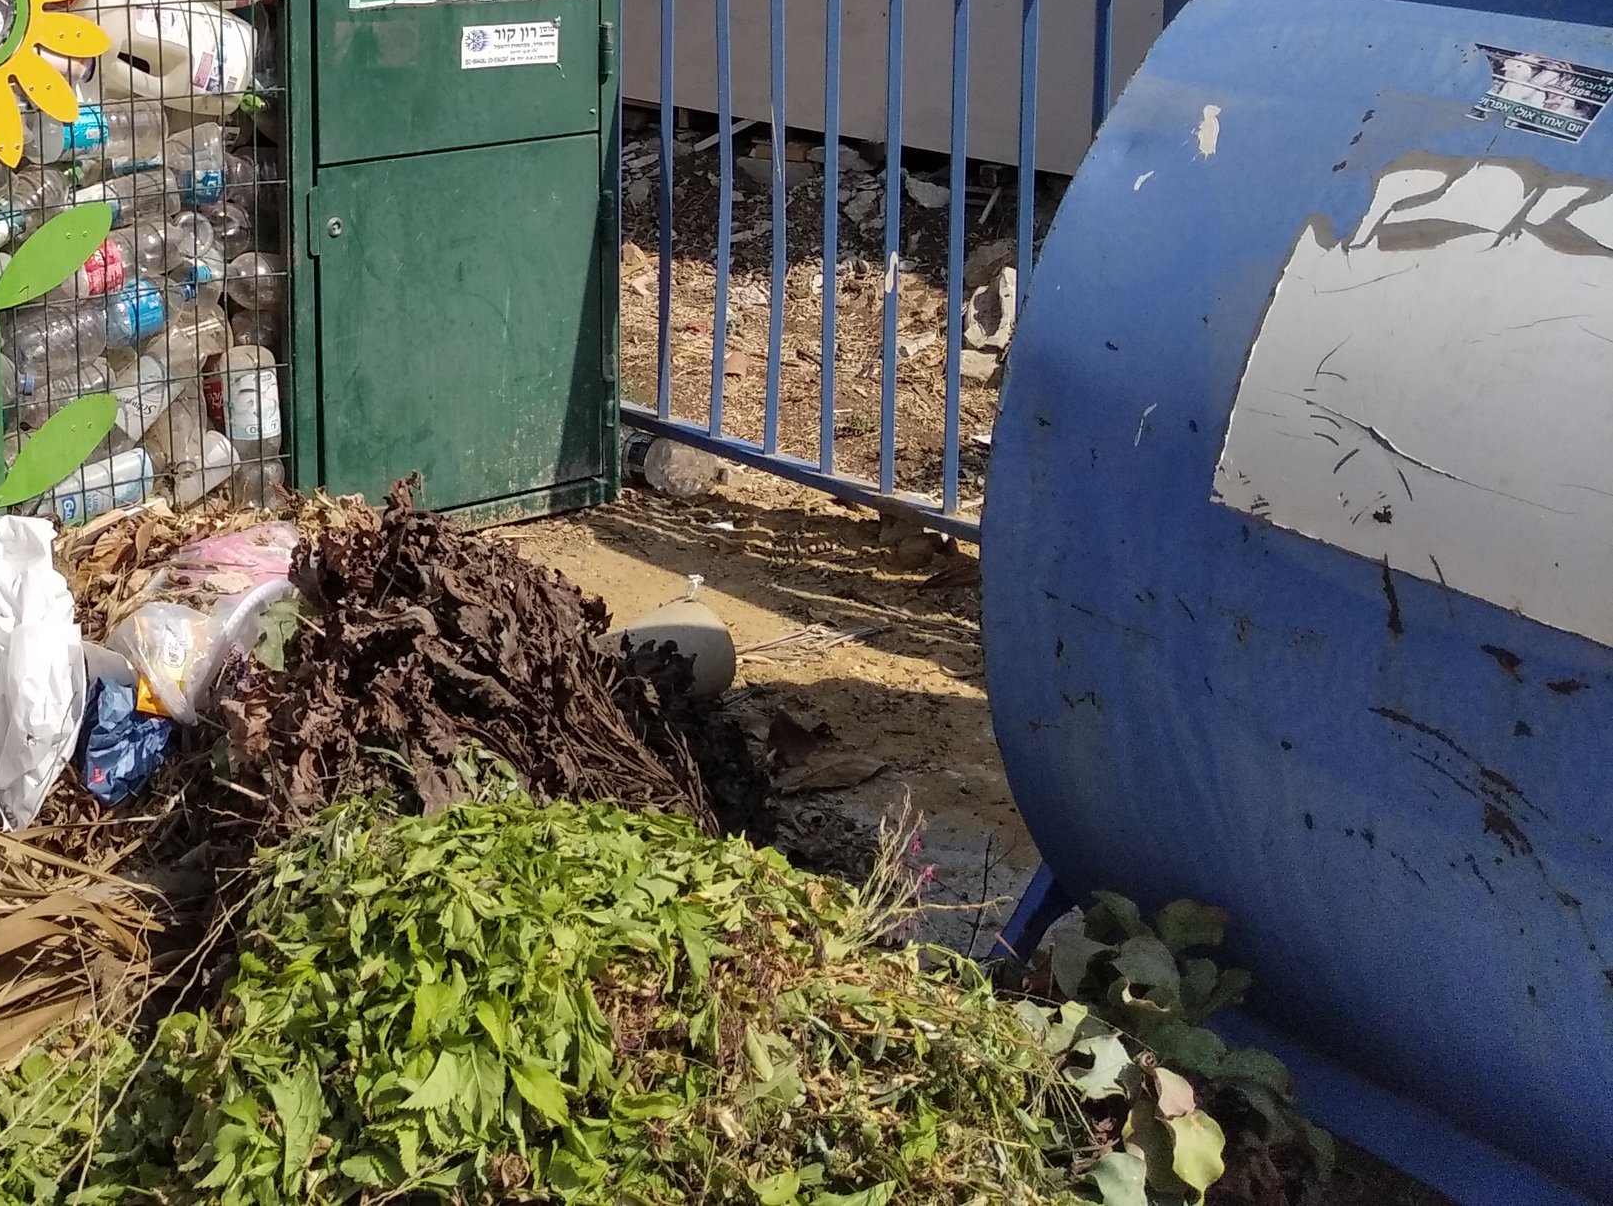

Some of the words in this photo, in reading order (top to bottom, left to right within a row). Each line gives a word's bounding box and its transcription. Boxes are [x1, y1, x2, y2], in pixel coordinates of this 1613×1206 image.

[494, 27, 516, 43] קור
[520, 27, 537, 42] רון
[1514, 106, 1536, 120] אולי
[1540, 114, 1564, 127] אחד
[1567, 122, 1584, 134] יום
